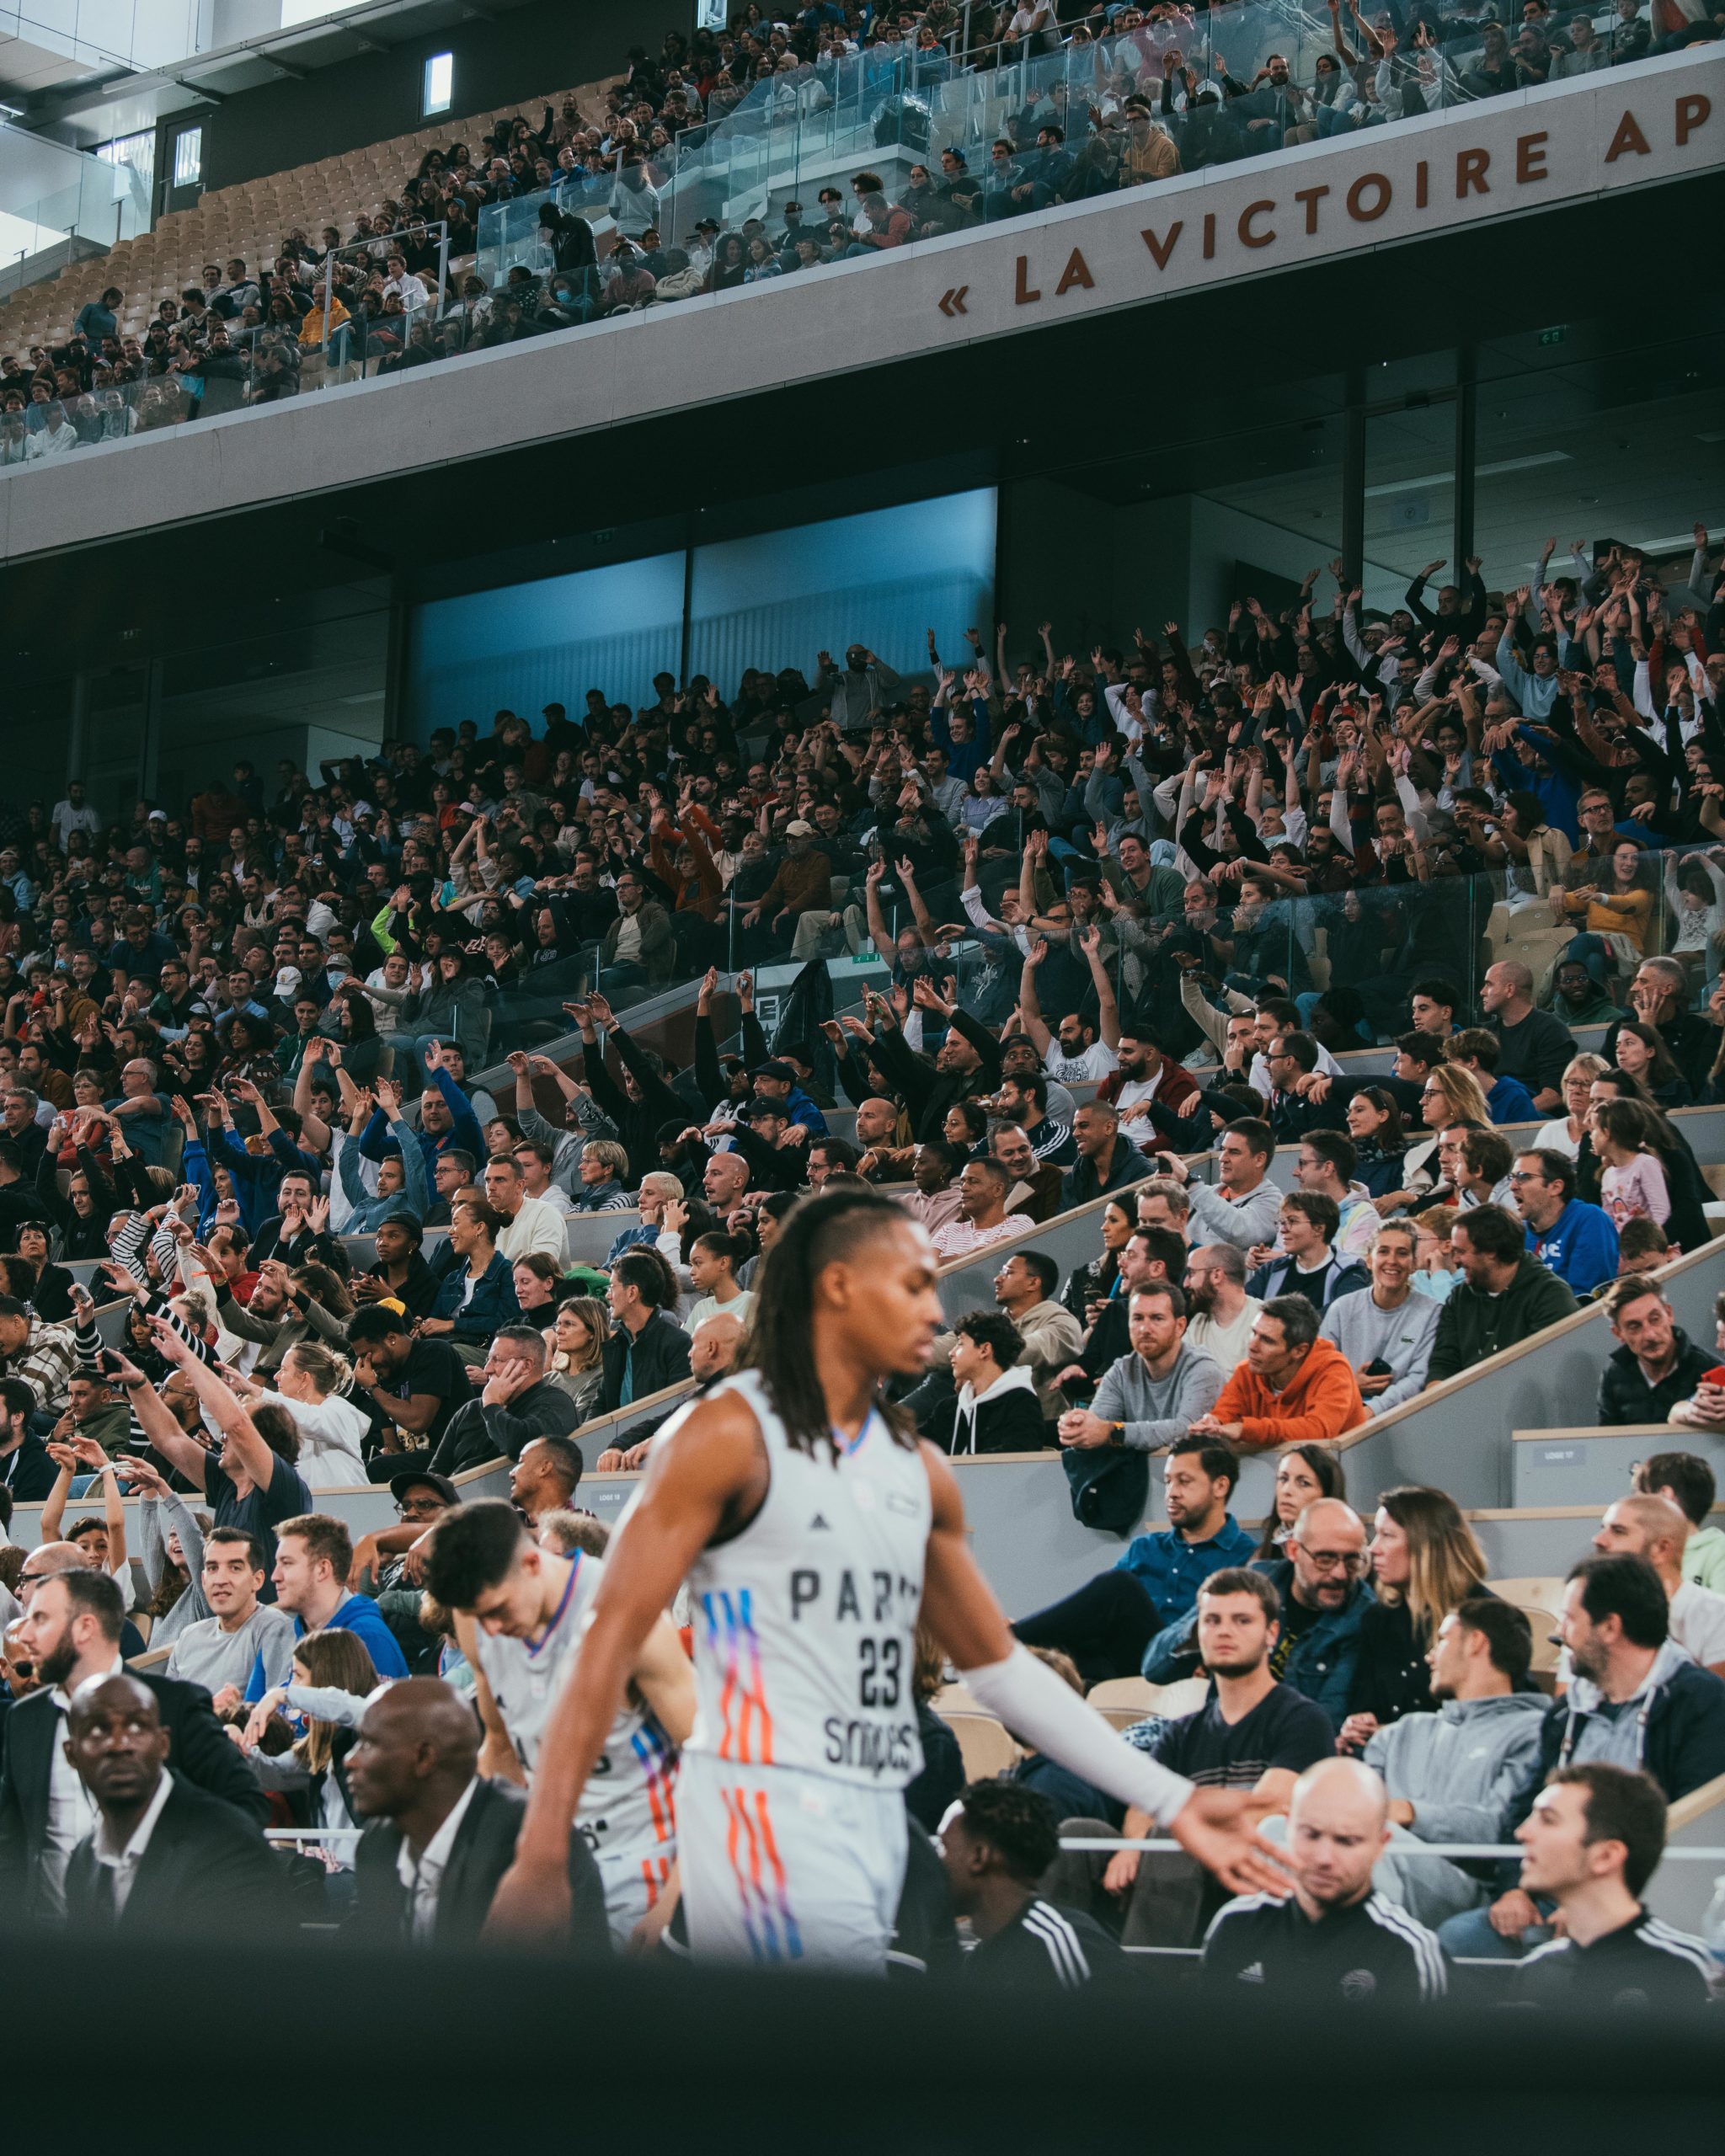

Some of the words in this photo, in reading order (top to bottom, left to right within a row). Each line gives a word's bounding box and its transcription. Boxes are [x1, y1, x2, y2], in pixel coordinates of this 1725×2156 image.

[1015, 247, 1095, 305] LA
[1140, 131, 1548, 271] VICTOIRE
[1605, 93, 1712, 162] AP
[791, 1569, 918, 1621] PAR
[860, 1638, 900, 1707] 23
